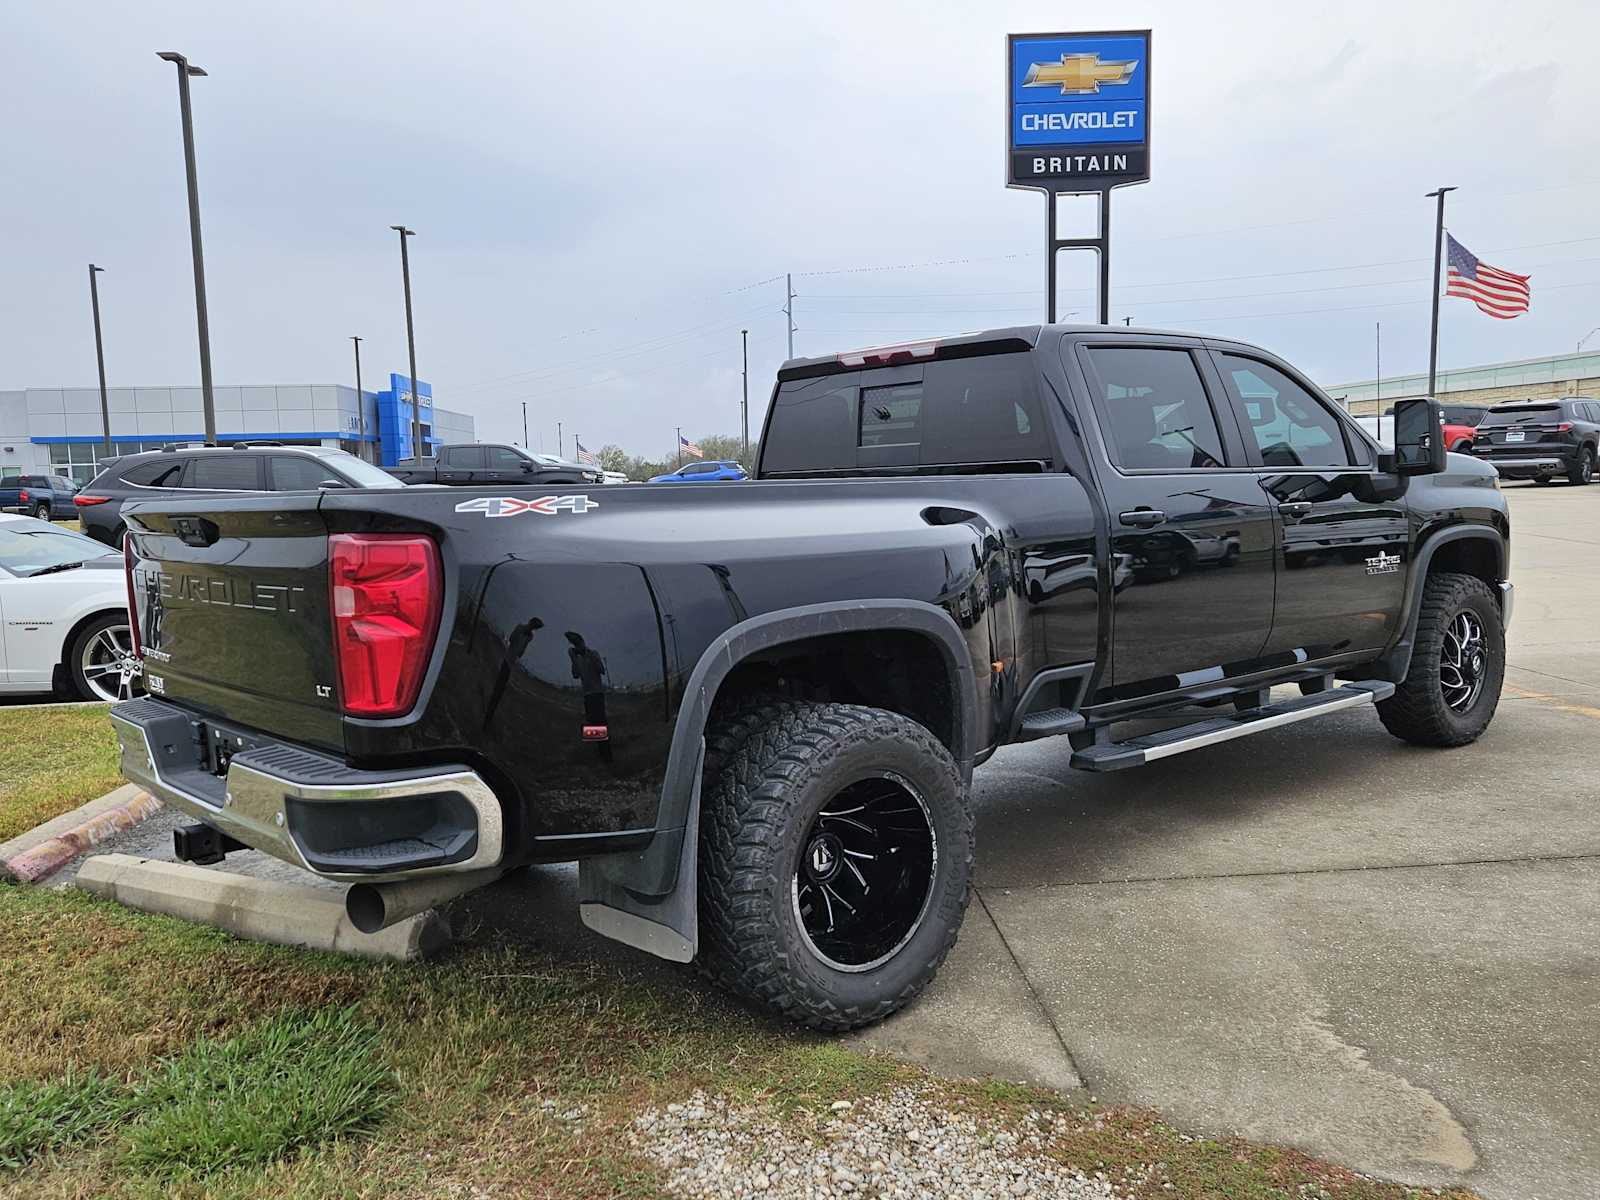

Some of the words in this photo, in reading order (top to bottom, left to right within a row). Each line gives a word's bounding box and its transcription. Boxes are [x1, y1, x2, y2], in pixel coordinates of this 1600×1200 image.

[1022, 111, 1138, 131] CHEVROLET
[1033, 154, 1127, 174] BRITAIN
[134, 568, 305, 613] CHEVROLET
[316, 685, 331, 698] LT
